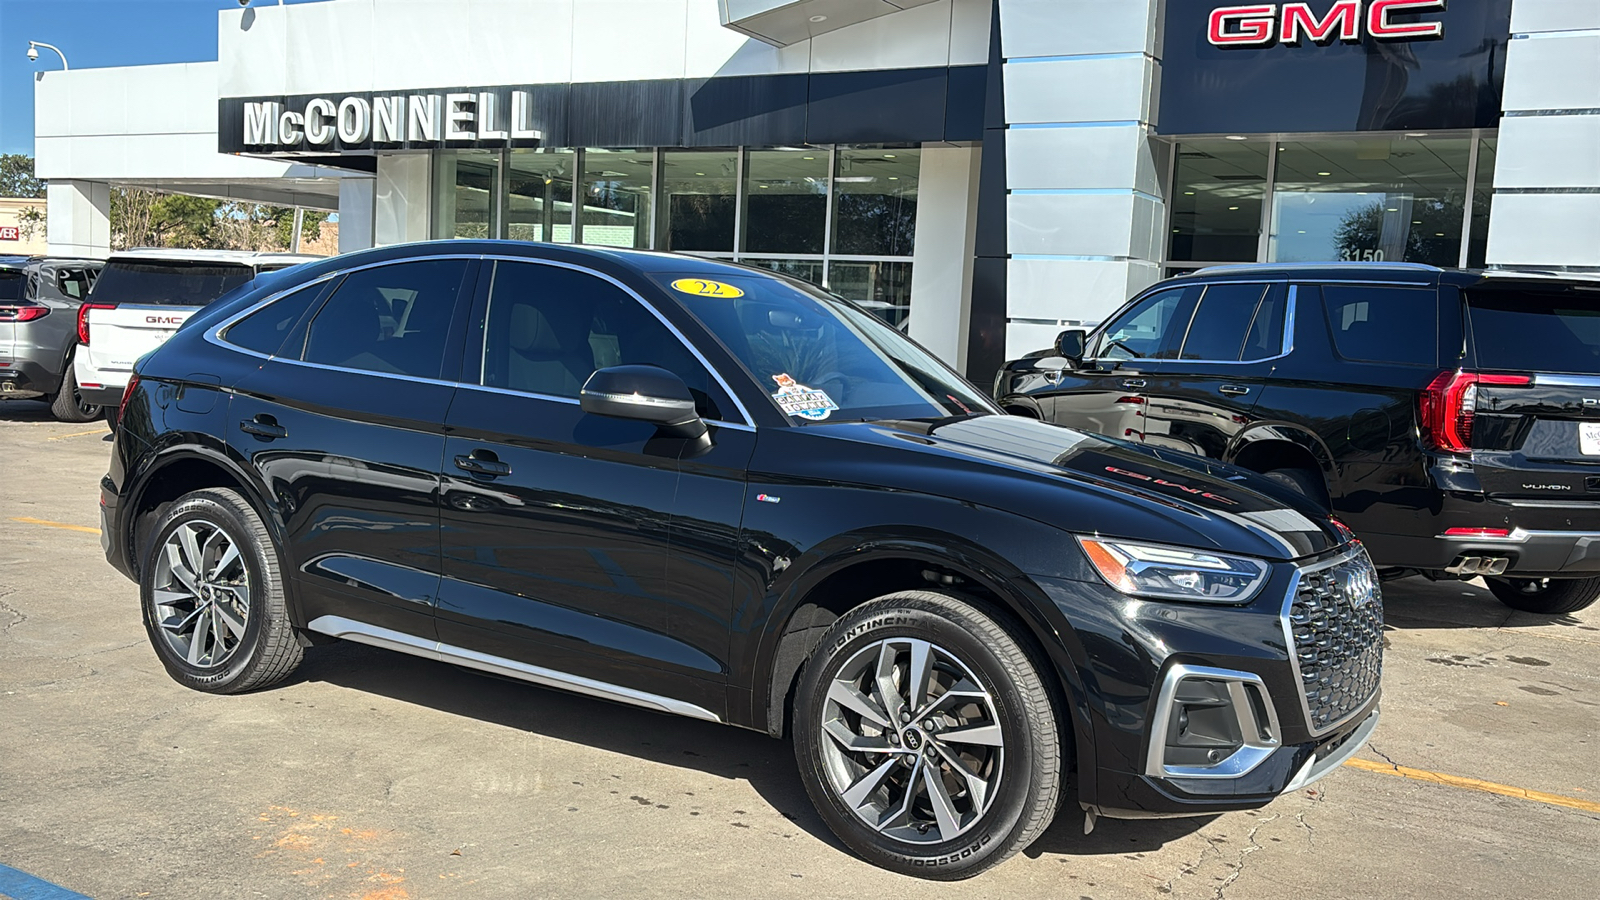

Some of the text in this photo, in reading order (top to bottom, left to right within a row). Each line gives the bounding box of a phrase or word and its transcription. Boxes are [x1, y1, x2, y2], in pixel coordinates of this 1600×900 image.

[1207, 0, 1447, 45] GMC
[243, 91, 541, 146] McCONNELL
[1341, 248, 1384, 262] 3150
[695, 281, 723, 295] 22
[146, 316, 183, 324] GMC
[1522, 483, 1571, 491] YUKON
[828, 617, 940, 656] CONTINENTA
[866, 833, 992, 868] CROSSCONTAC
